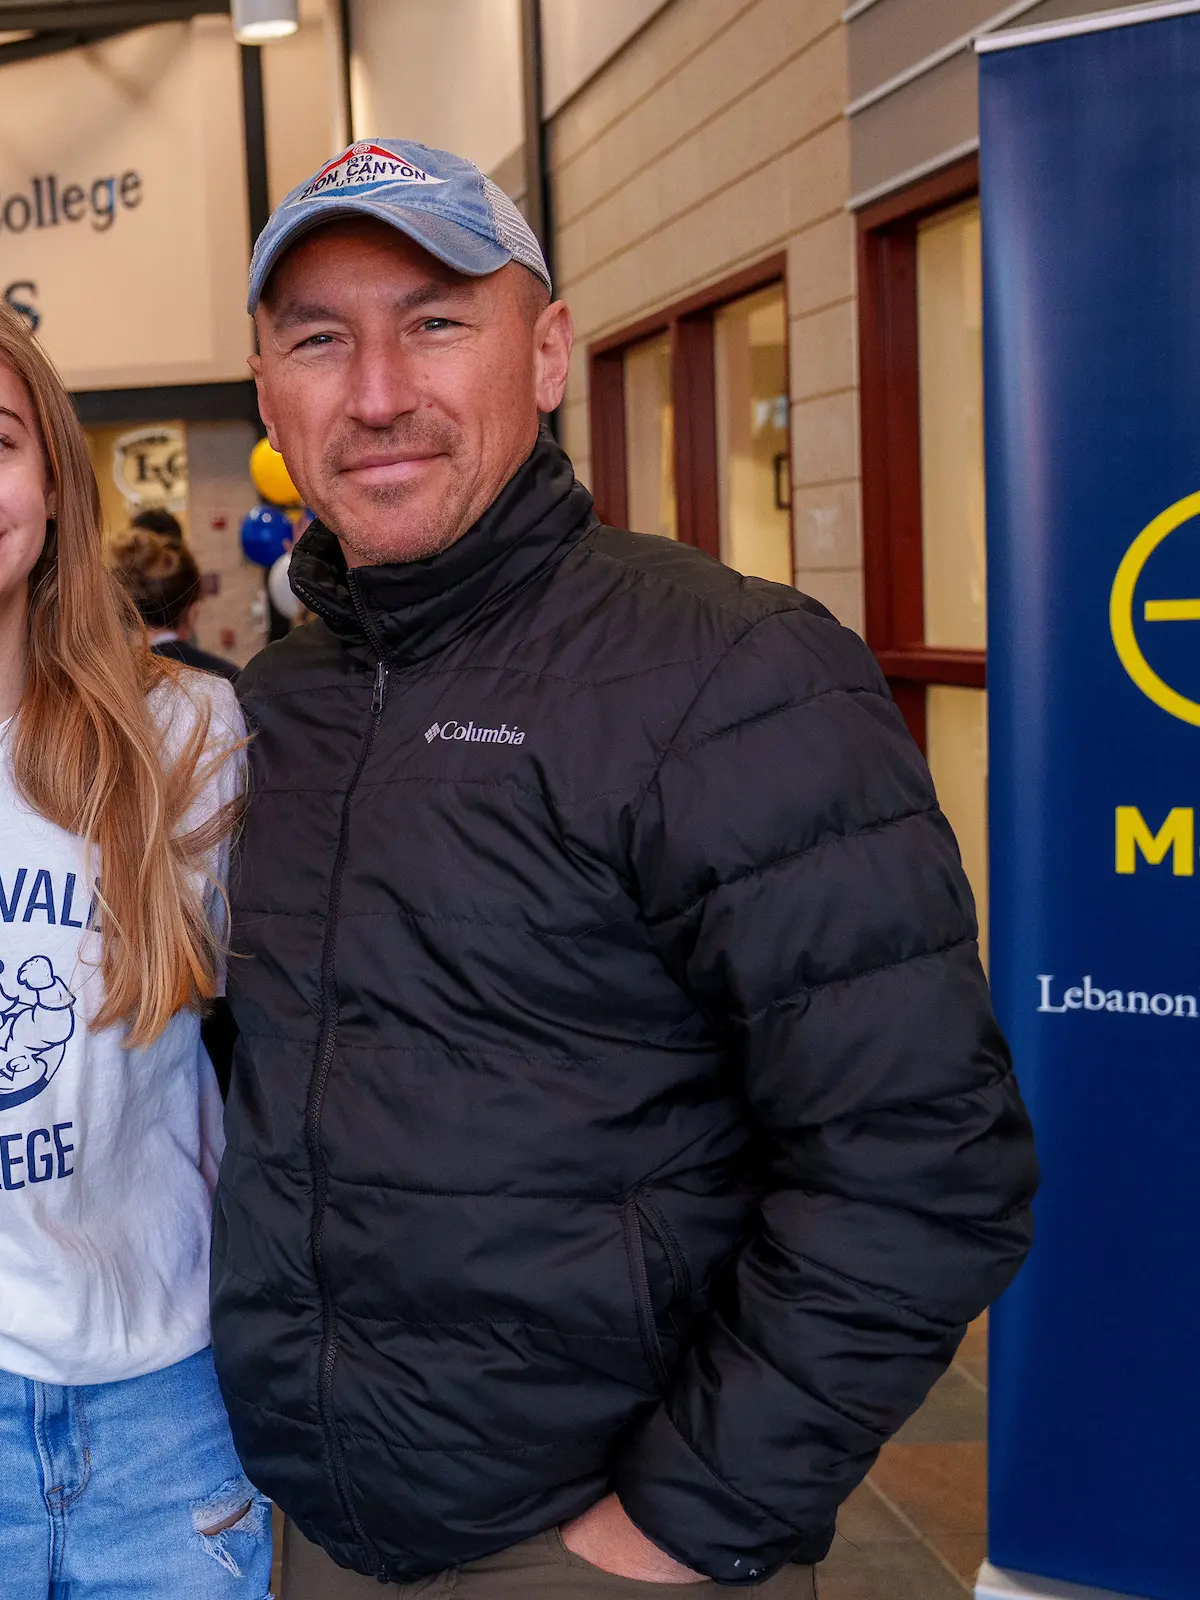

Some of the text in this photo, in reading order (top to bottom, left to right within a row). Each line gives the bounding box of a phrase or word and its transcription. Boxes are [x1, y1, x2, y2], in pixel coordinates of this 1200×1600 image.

[346, 155, 373, 166] 1919
[300, 161, 426, 200] ZION CANYON
[336, 175, 376, 187] UTAH
[440, 720, 526, 745] Columbia
[1036, 974, 1198, 1018] Lebanon
